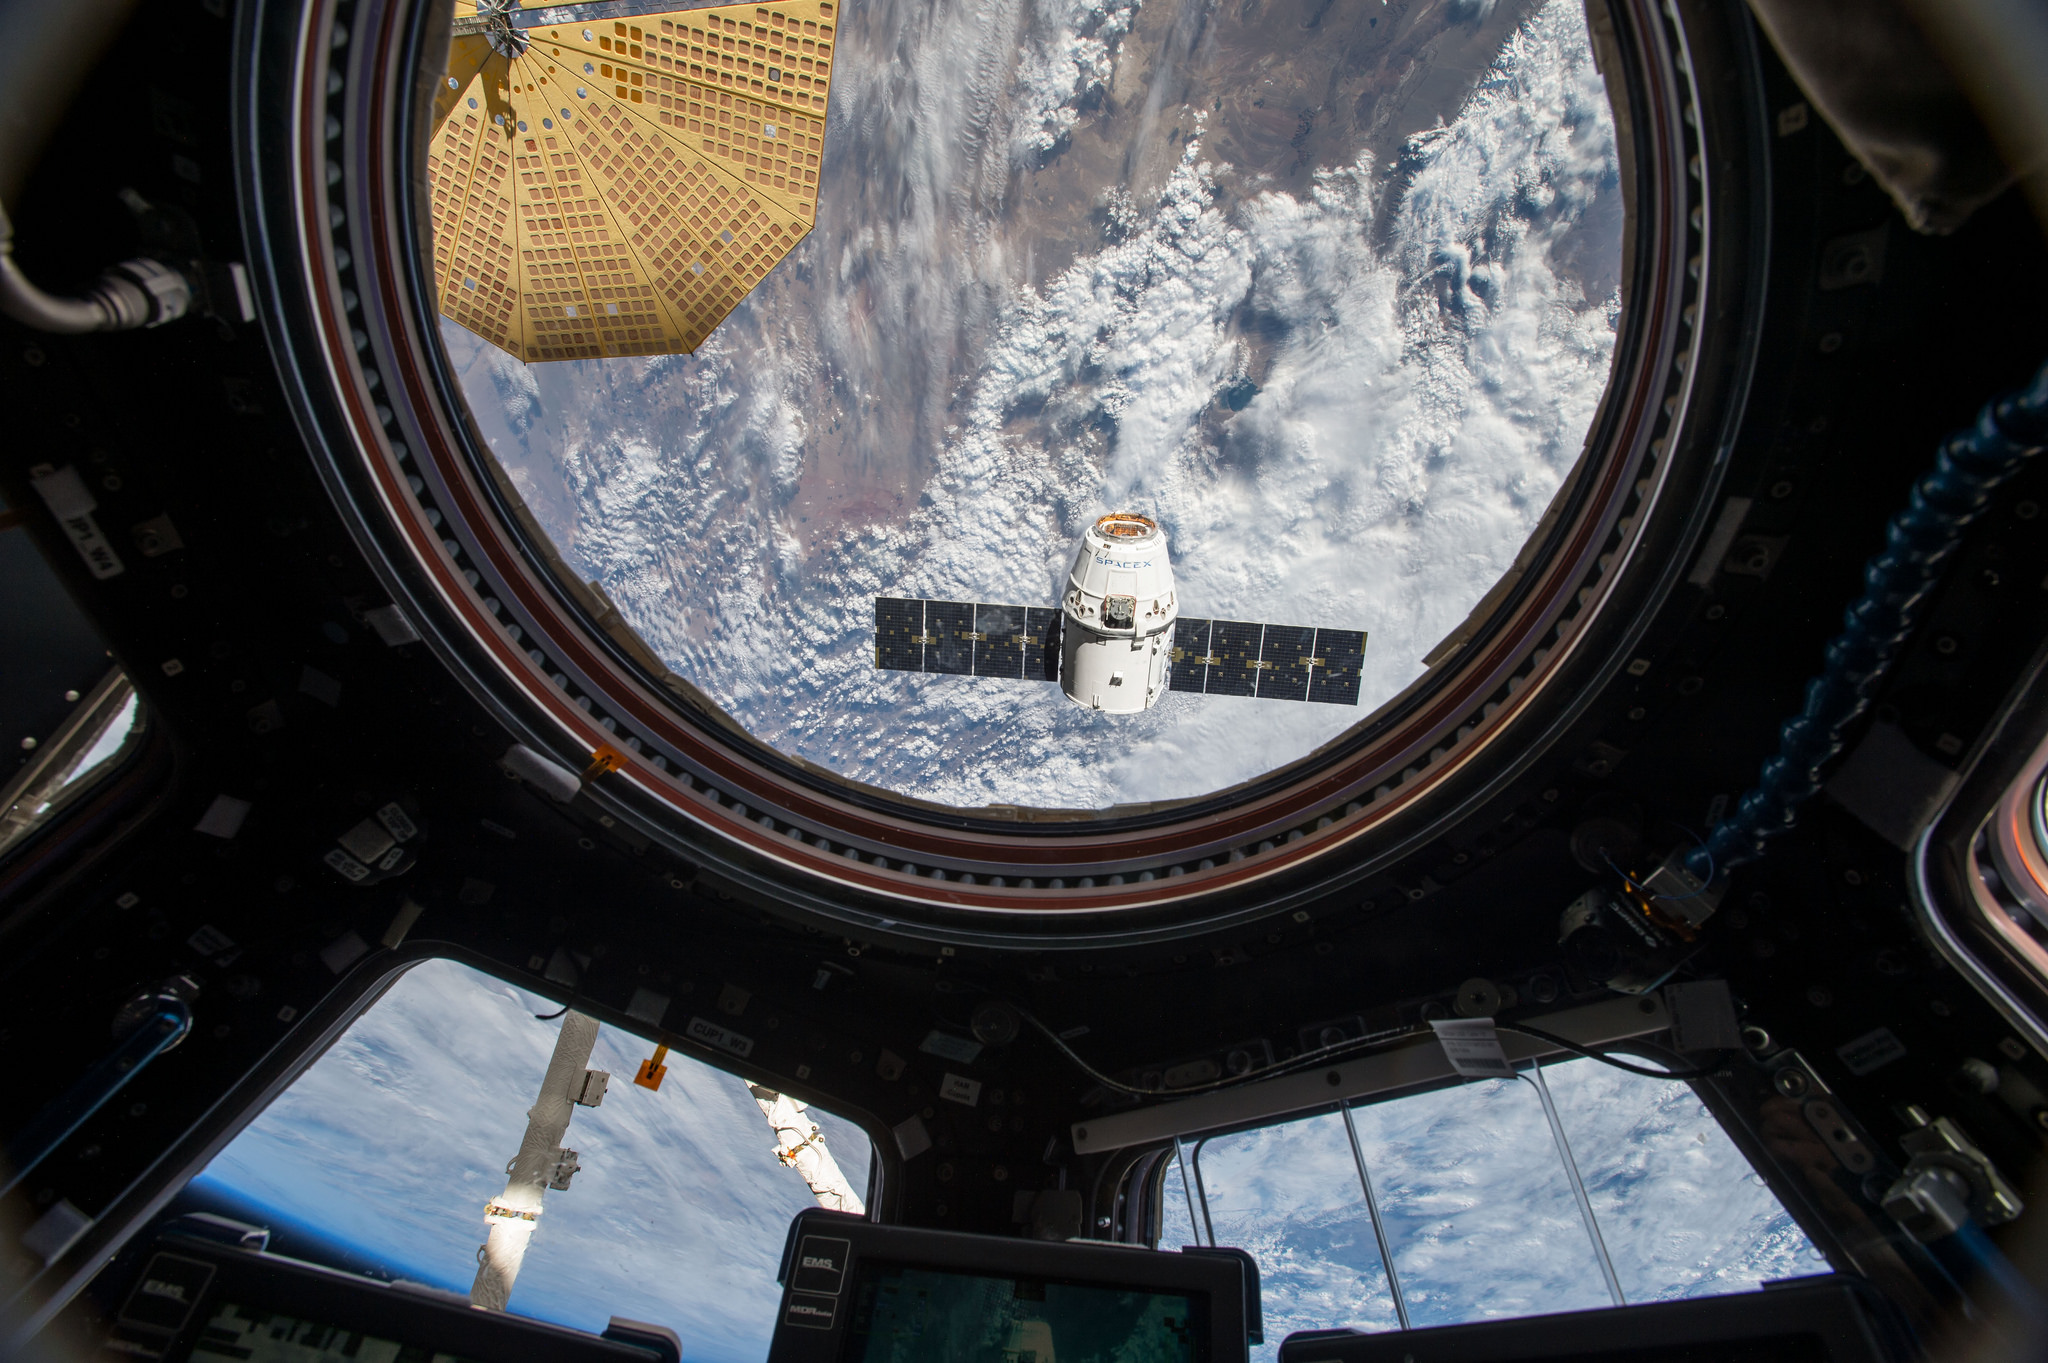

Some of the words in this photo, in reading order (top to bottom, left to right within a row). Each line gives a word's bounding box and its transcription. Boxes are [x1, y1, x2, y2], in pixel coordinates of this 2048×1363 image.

[1096, 556, 1152, 569] SPACEX
[802, 1256, 833, 1269] EMS
[789, 1304, 817, 1316] MDR
